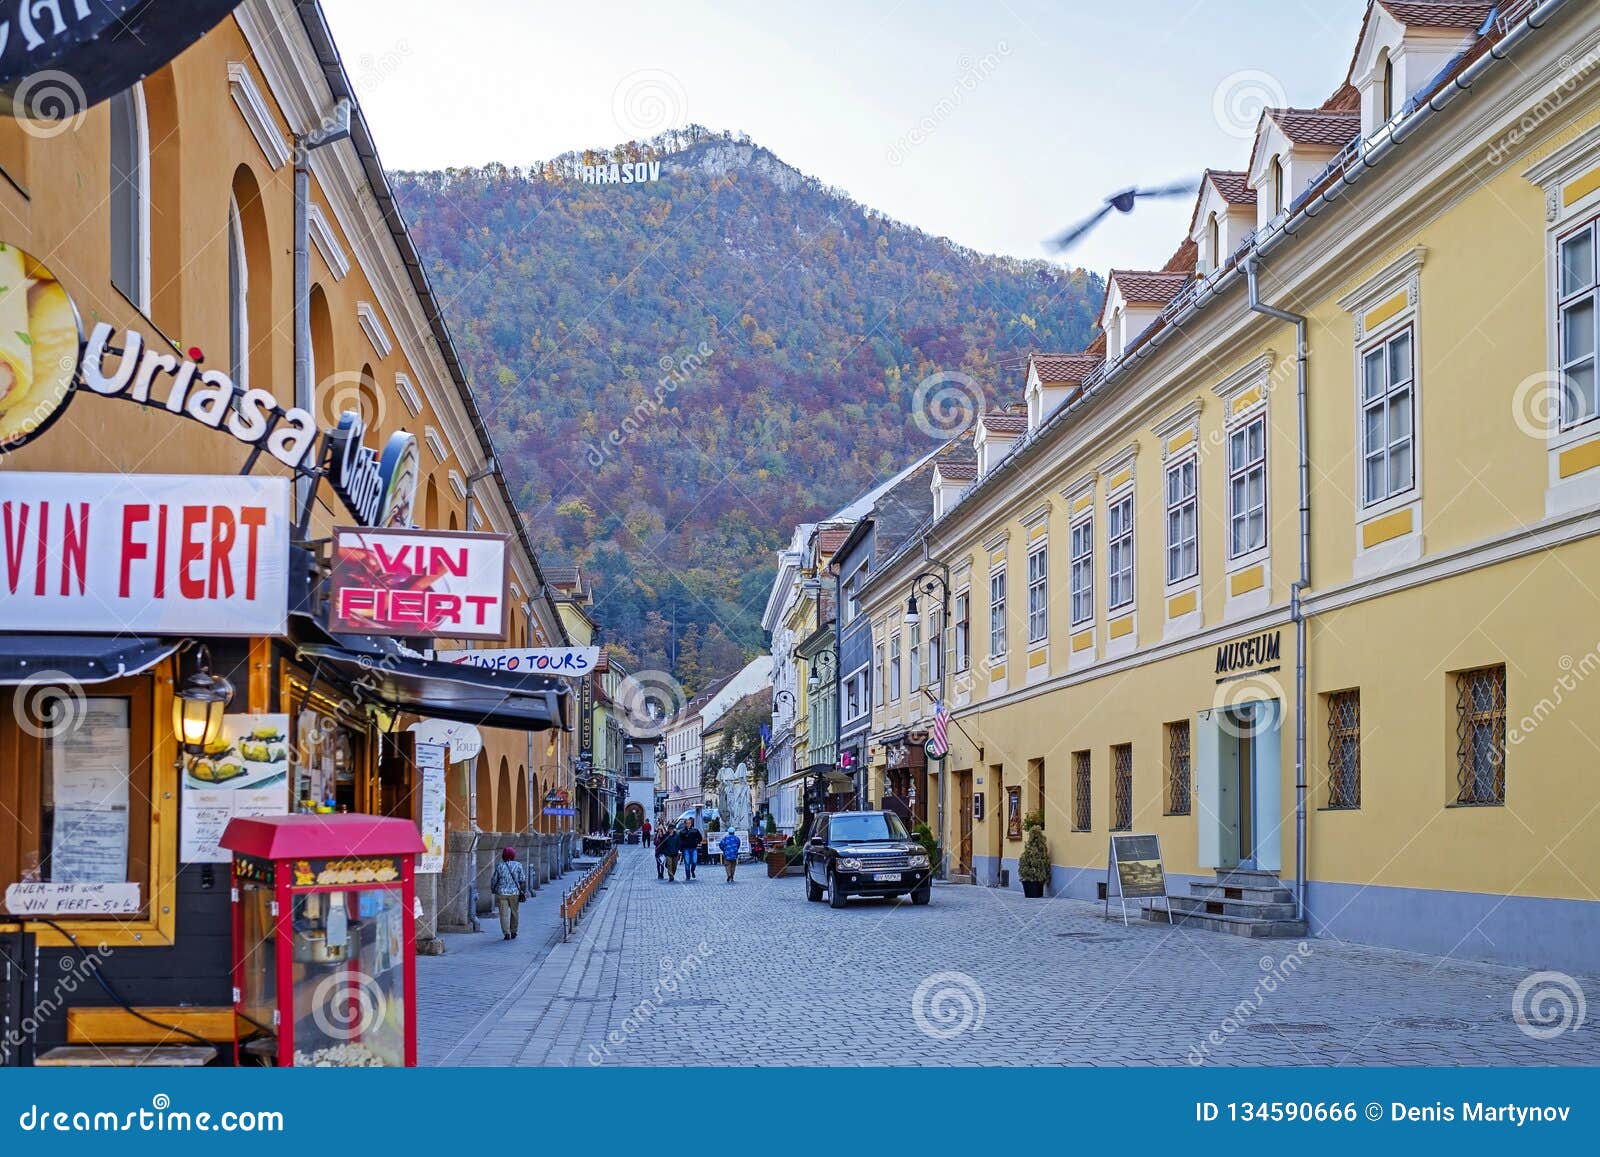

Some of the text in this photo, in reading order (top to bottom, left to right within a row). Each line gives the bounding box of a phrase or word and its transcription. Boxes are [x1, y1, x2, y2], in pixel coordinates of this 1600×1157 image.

[582, 161, 660, 184] BRASOV
[82, 322, 317, 467] Uriasa
[3, 501, 267, 600] VIN FIERT
[373, 543, 468, 577] VIN
[339, 587, 498, 625] FIERT
[526, 653, 588, 670] TOURS
[1215, 631, 1280, 674] MUSEUM
